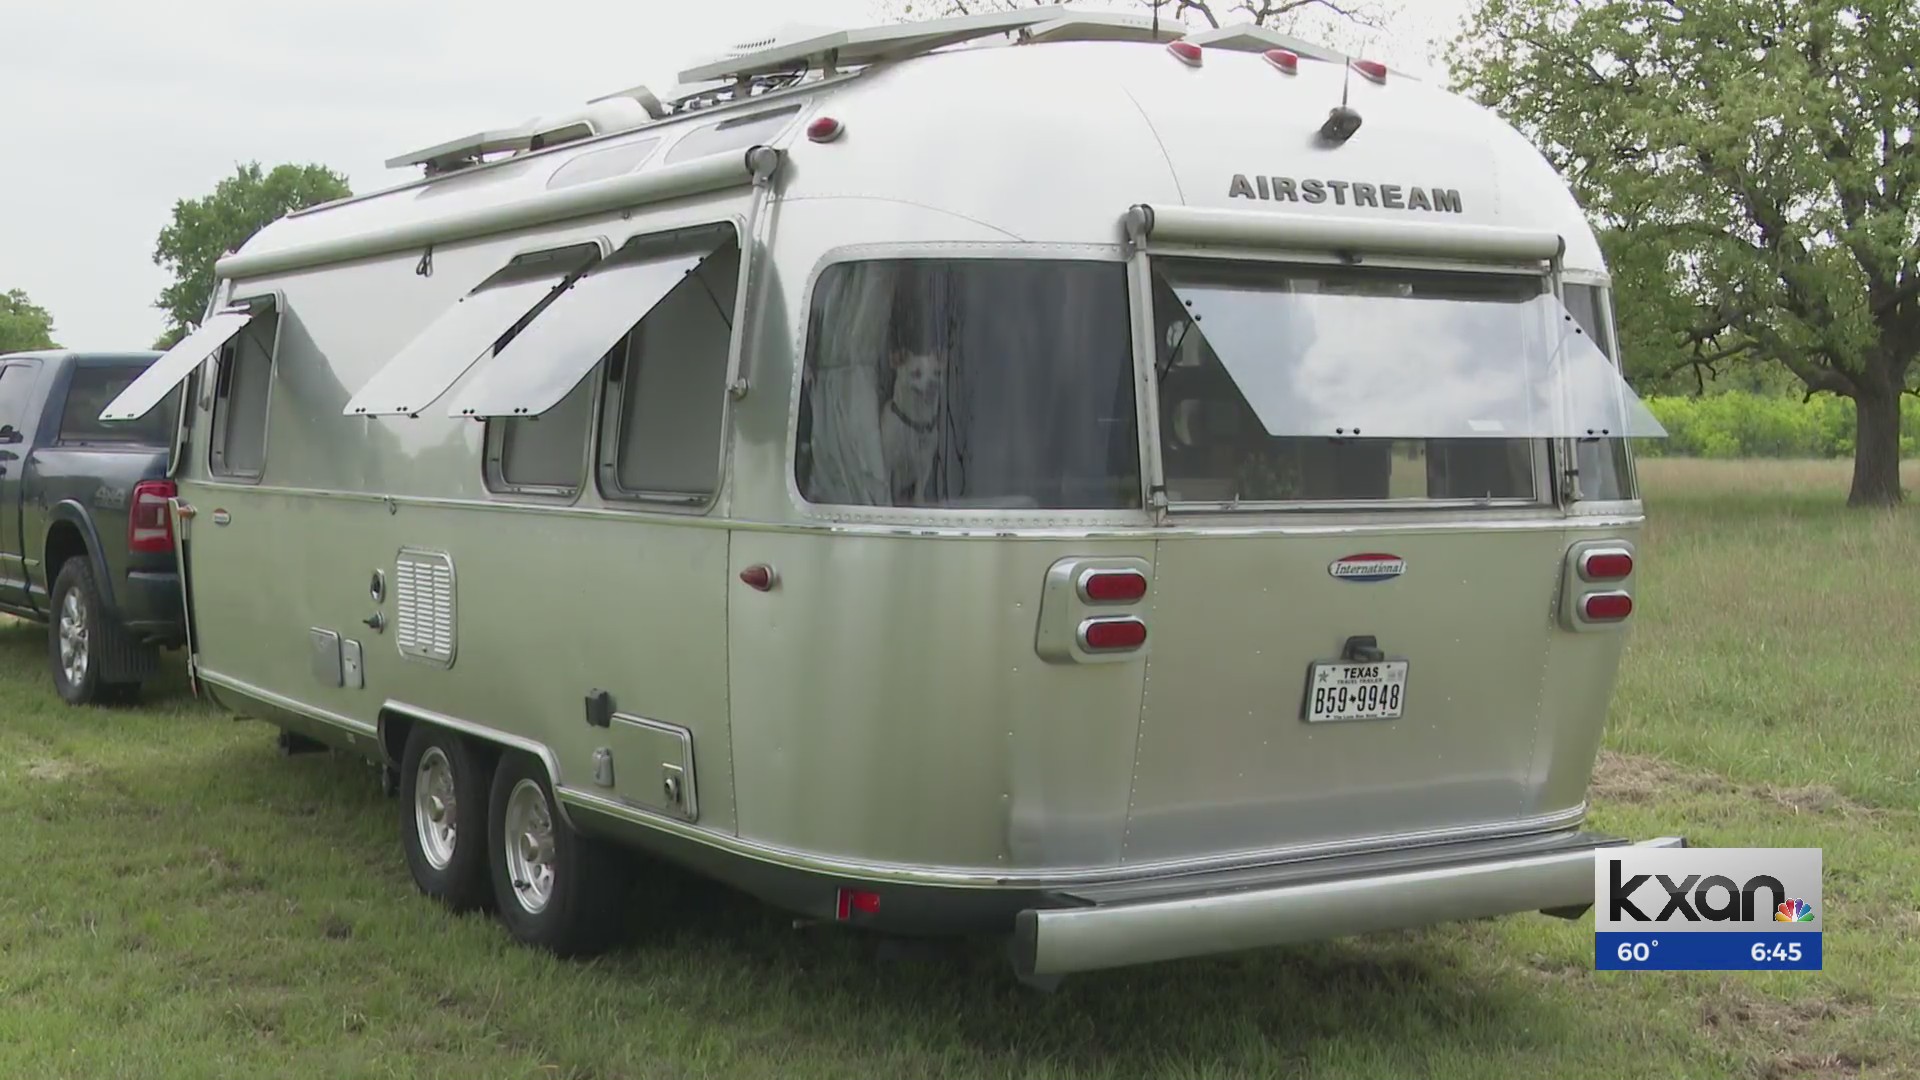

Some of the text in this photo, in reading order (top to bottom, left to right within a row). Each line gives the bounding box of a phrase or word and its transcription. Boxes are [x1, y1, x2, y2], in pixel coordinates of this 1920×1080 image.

[1228, 173, 1463, 213] AIRSTREAM
[1335, 561, 1404, 575] International
[1343, 666, 1379, 679] TEXAS
